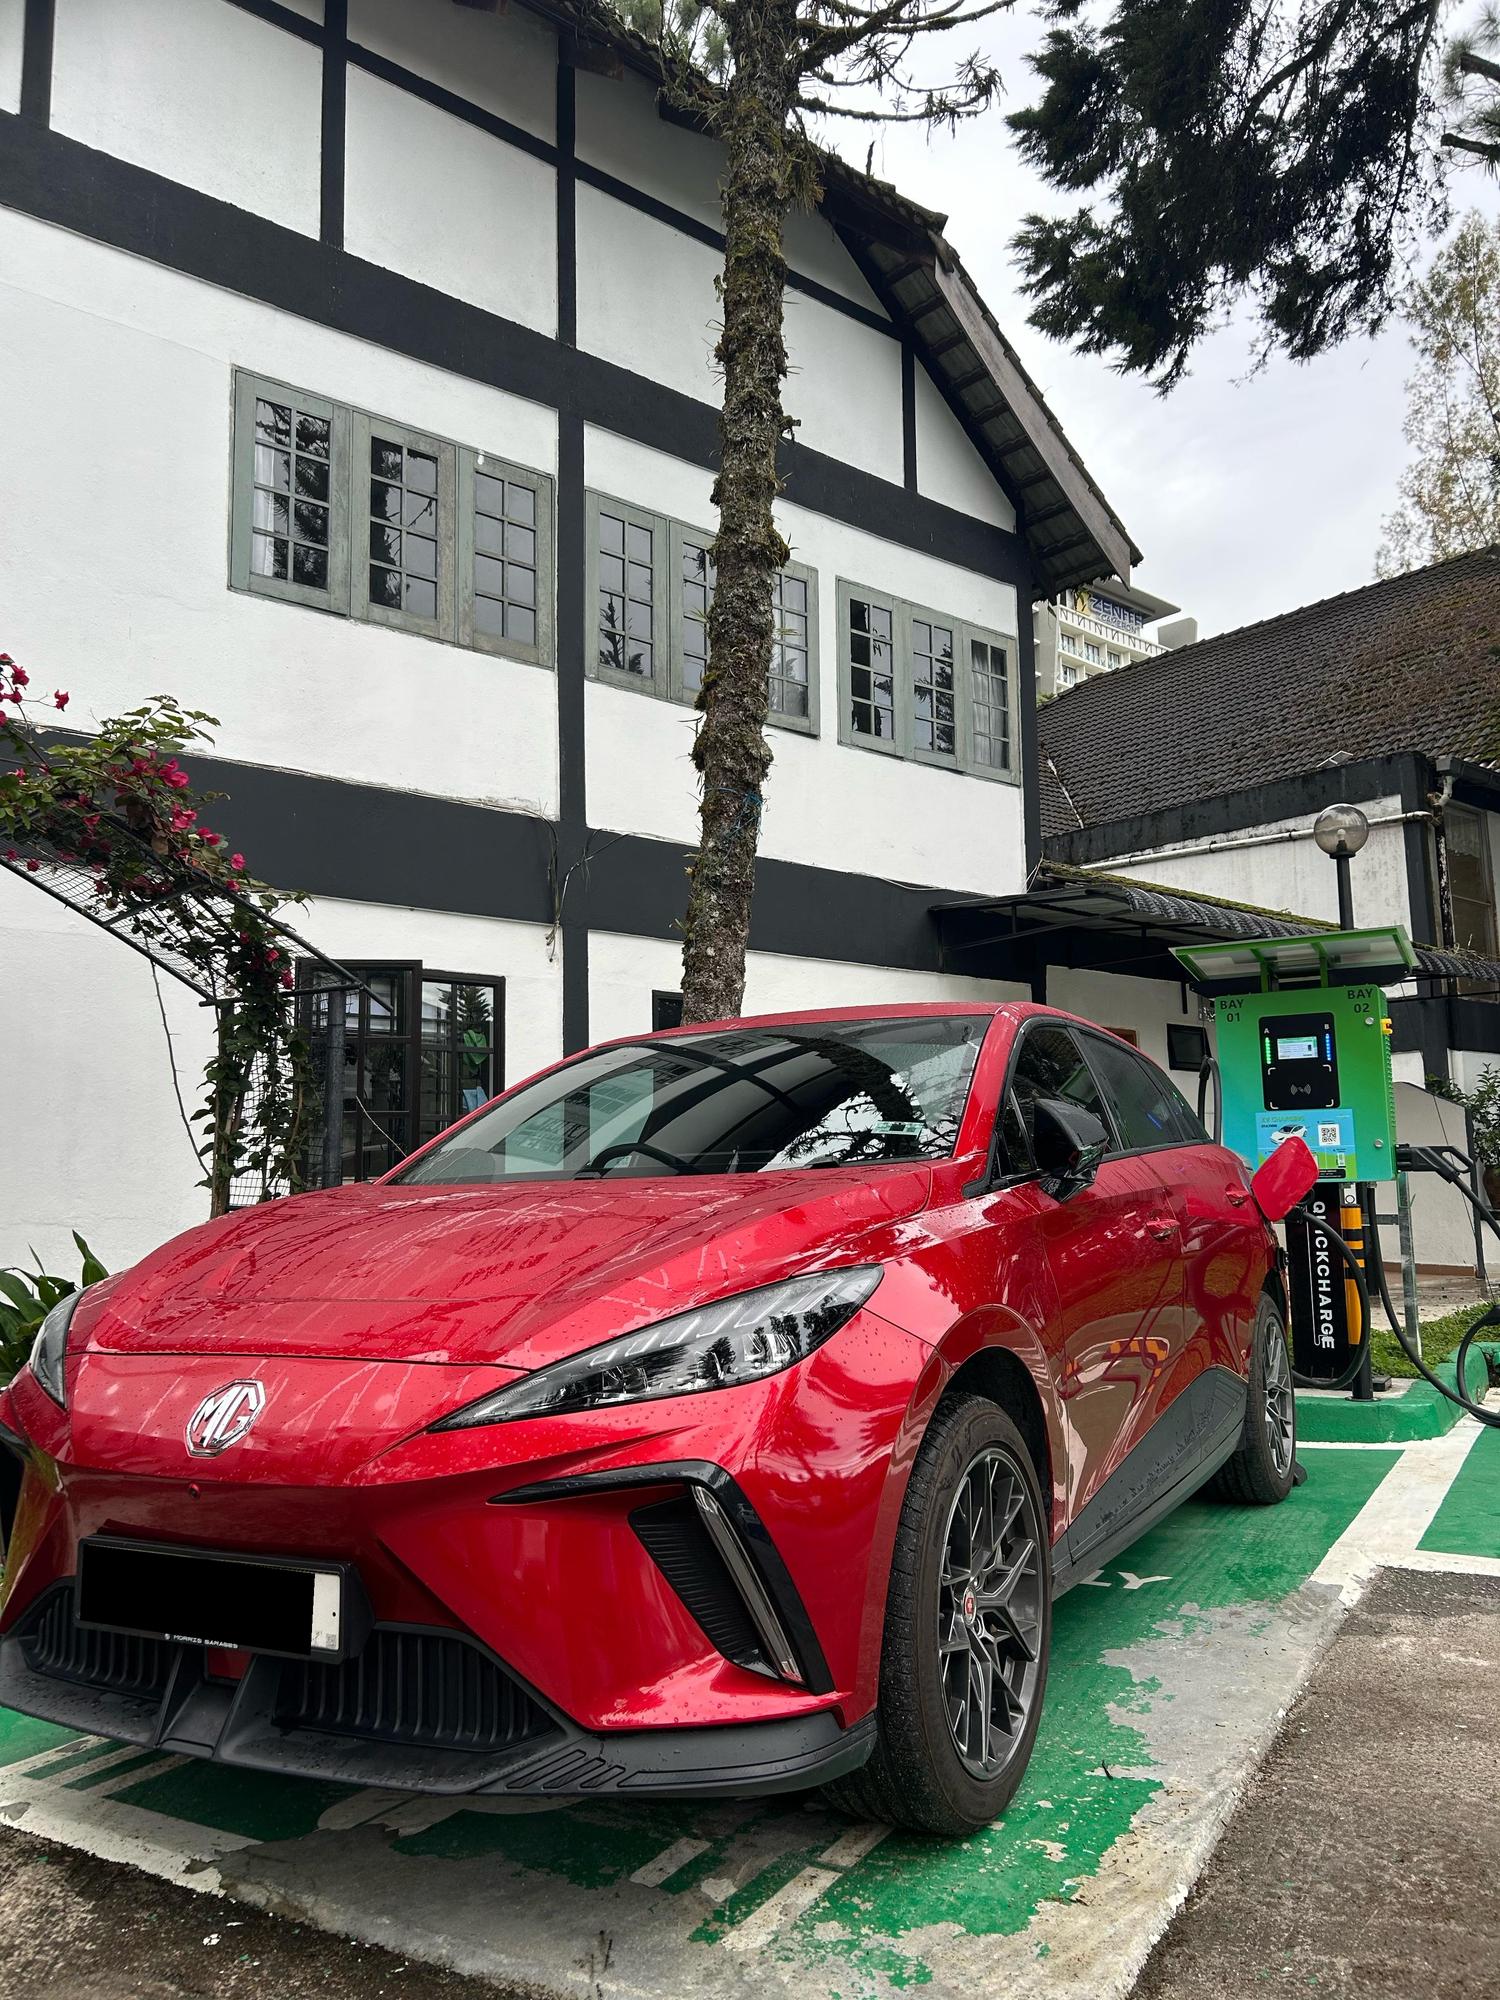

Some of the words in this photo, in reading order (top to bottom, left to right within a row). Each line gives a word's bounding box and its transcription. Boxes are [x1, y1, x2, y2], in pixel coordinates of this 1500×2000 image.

[1347, 988, 1373, 1000] BAY
[1220, 999, 1244, 1010] BAY
[1353, 1003, 1370, 1014] 02
[1226, 1012, 1241, 1023] 01
[191, 1385, 258, 1448] MG
[173, 1634, 202, 1644] MORRIS
